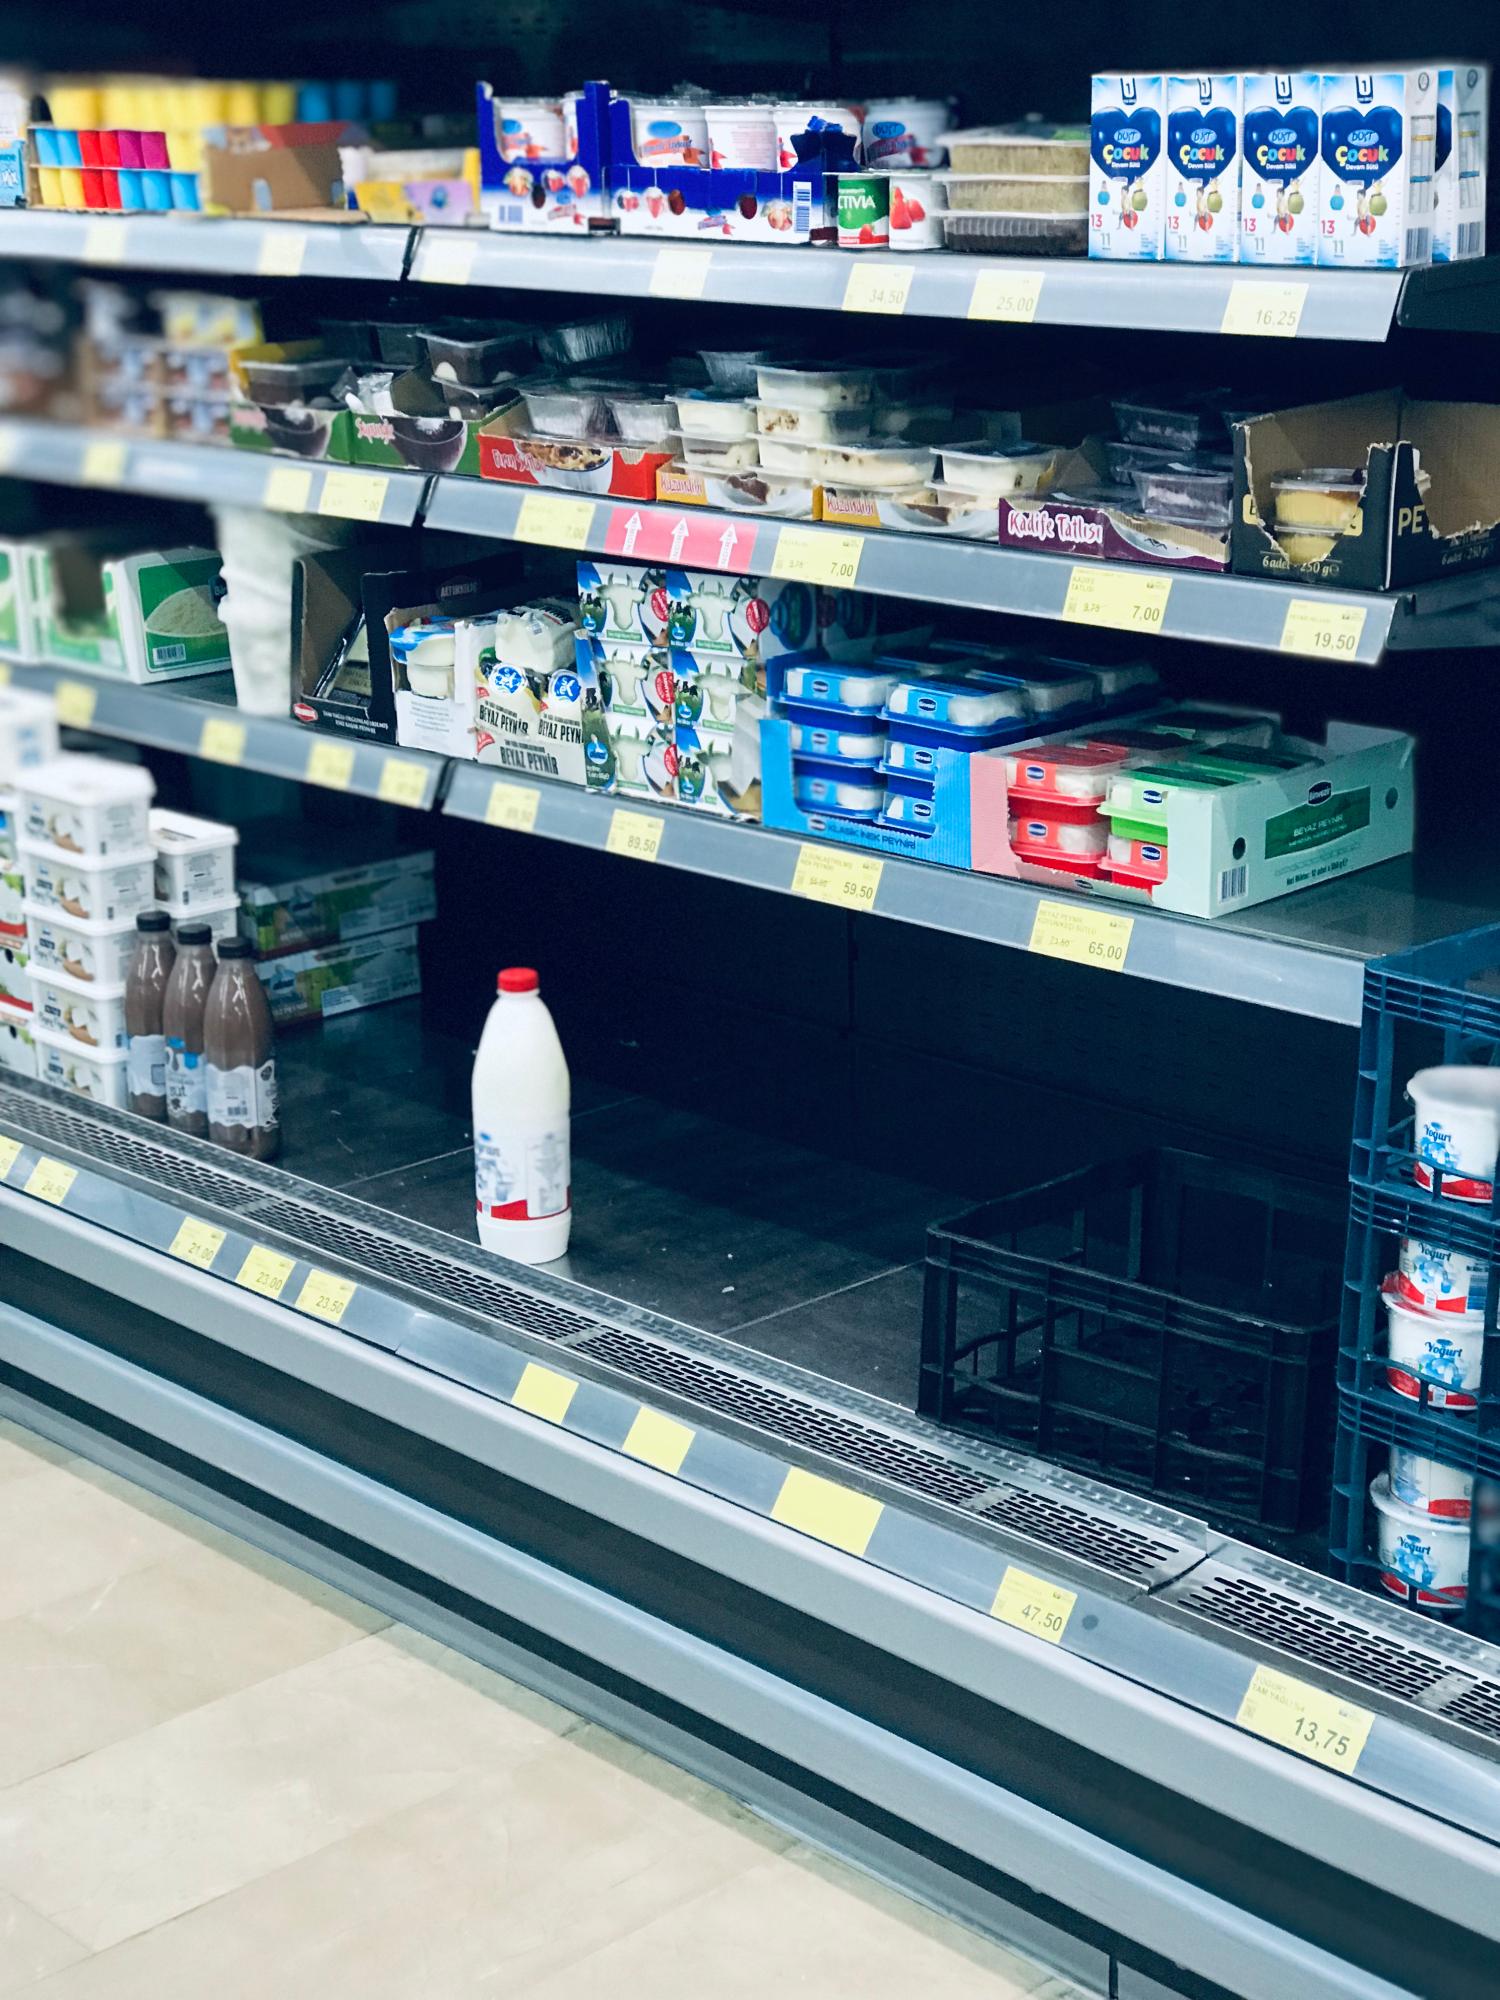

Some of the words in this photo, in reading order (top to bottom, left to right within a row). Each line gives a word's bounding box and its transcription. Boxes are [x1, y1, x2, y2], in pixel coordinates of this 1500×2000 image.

[1102, 144, 1149, 164] Çocuk
[1179, 144, 1225, 165] Çocuk
[1256, 144, 1306, 167] Çocuk
[1335, 145, 1389, 167] Çocuk
[1008, 510, 1055, 540] Kadife
[1055, 514, 1103, 543] Tatlısı
[479, 704, 499, 727] BEYAZ
[500, 716, 529, 735] PEYNİR
[538, 718, 558, 740] BEYAZ
[500, 745, 526, 769] BEYAZ
[527, 753, 559, 775] PEYNİR
[1295, 1717, 1351, 1757] 13,75
